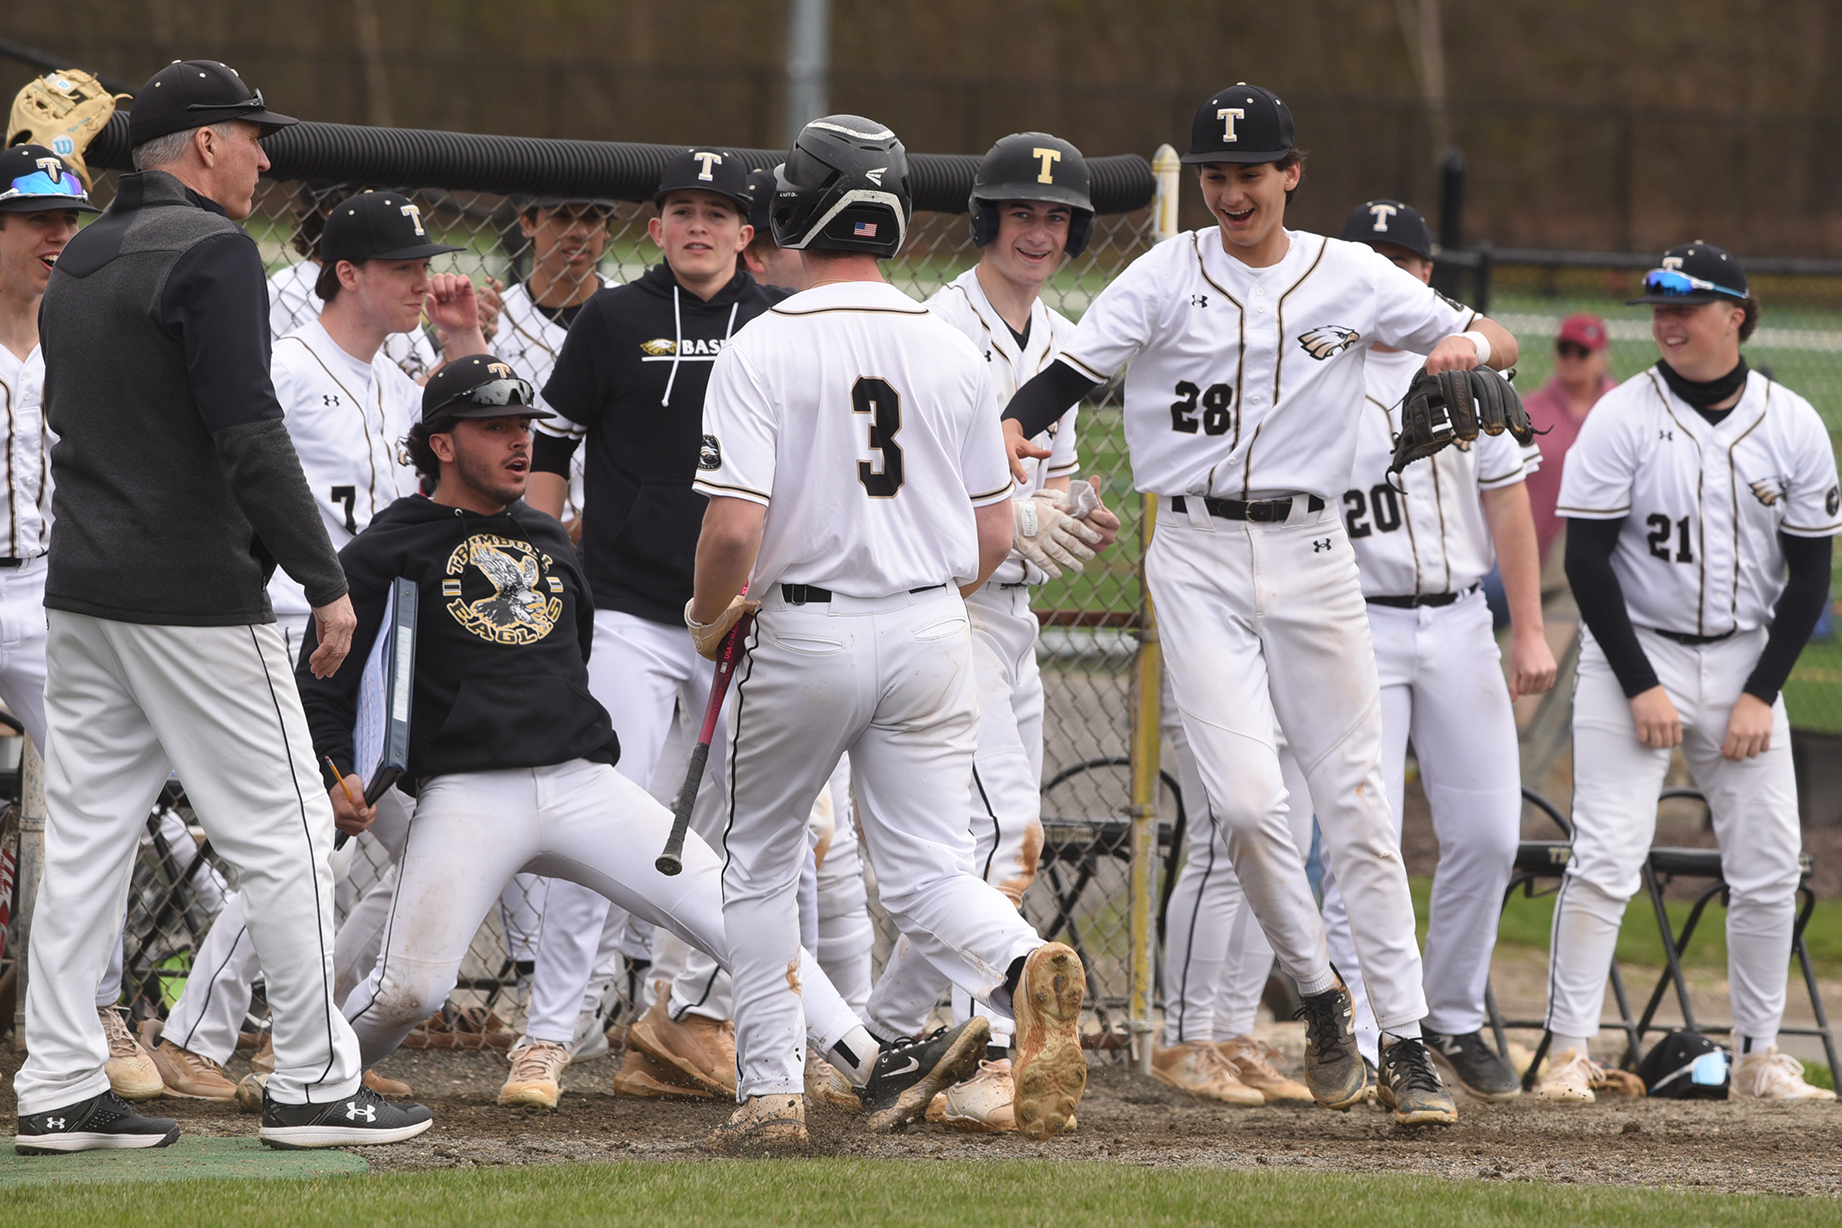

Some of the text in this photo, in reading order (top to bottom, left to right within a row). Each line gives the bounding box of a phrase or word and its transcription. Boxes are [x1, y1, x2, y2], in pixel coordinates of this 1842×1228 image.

[1217, 108, 1245, 142] T
[35, 157, 62, 183] T
[694, 152, 722, 181] T
[1033, 147, 1061, 184] T
[400, 204, 425, 236] T
[1370, 204, 1397, 232] T
[487, 362, 511, 378] T
[1170, 380, 1233, 436] 28
[850, 375, 905, 499] 3
[331, 485, 357, 536] 7
[1343, 483, 1402, 540] 20
[1646, 512, 1693, 564] 21
